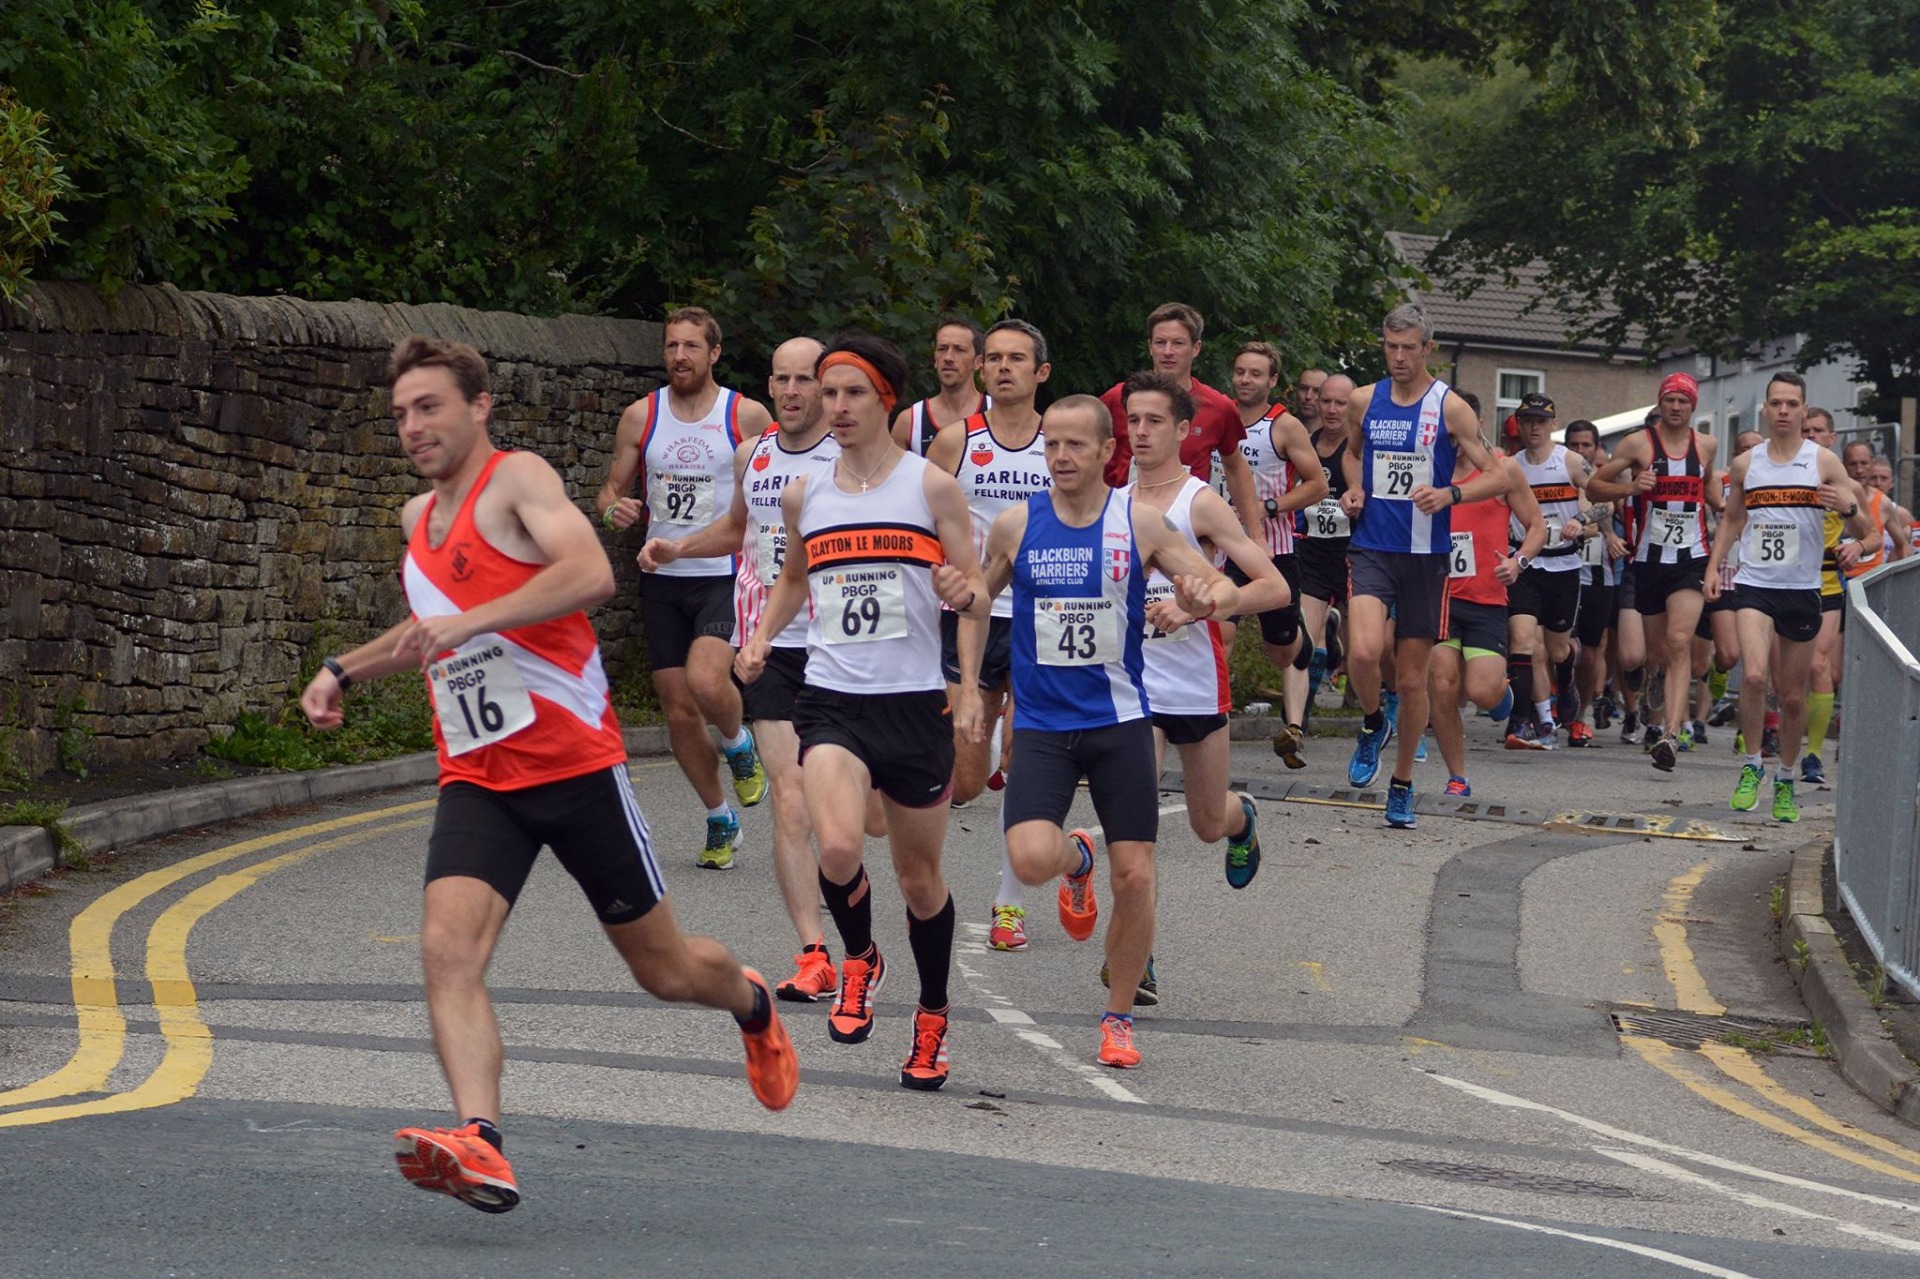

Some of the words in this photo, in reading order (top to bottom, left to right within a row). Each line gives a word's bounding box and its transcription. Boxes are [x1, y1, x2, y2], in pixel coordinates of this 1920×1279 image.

[1369, 420, 1412, 431] BLACKBURN
[1370, 430, 1407, 441] HARRIERS
[662, 436, 715, 460] WHARFEDALE
[1389, 462, 1413, 470] PBGP
[672, 474, 711, 483] RUNNING
[975, 471, 1052, 488] BARLICK
[1387, 471, 1414, 495] 29
[668, 483, 696, 493] PBGP
[667, 492, 696, 520] 92
[1317, 514, 1337, 534] 86
[1663, 525, 1684, 544] 73
[810, 537, 853, 558] CLAYTON
[857, 536, 868, 550] LE
[873, 535, 914, 551] MOORS
[1761, 539, 1785, 561] 58
[1028, 548, 1093, 563] BLACKBURN
[822, 576, 834, 585] UP
[845, 571, 897, 582] RUNNING
[1031, 563, 1088, 578] HARRIERS
[1036, 578, 1065, 586] ATHLETIC
[842, 584, 877, 598] PBGP
[1040, 602, 1053, 610] UP
[1064, 601, 1112, 611] RUNNING
[842, 597, 880, 636] 69
[1060, 613, 1095, 624] PBGP
[1058, 625, 1096, 659] 43
[447, 646, 504, 675] RUNNING
[447, 669, 486, 694] PBGP
[457, 685, 504, 739] 16
